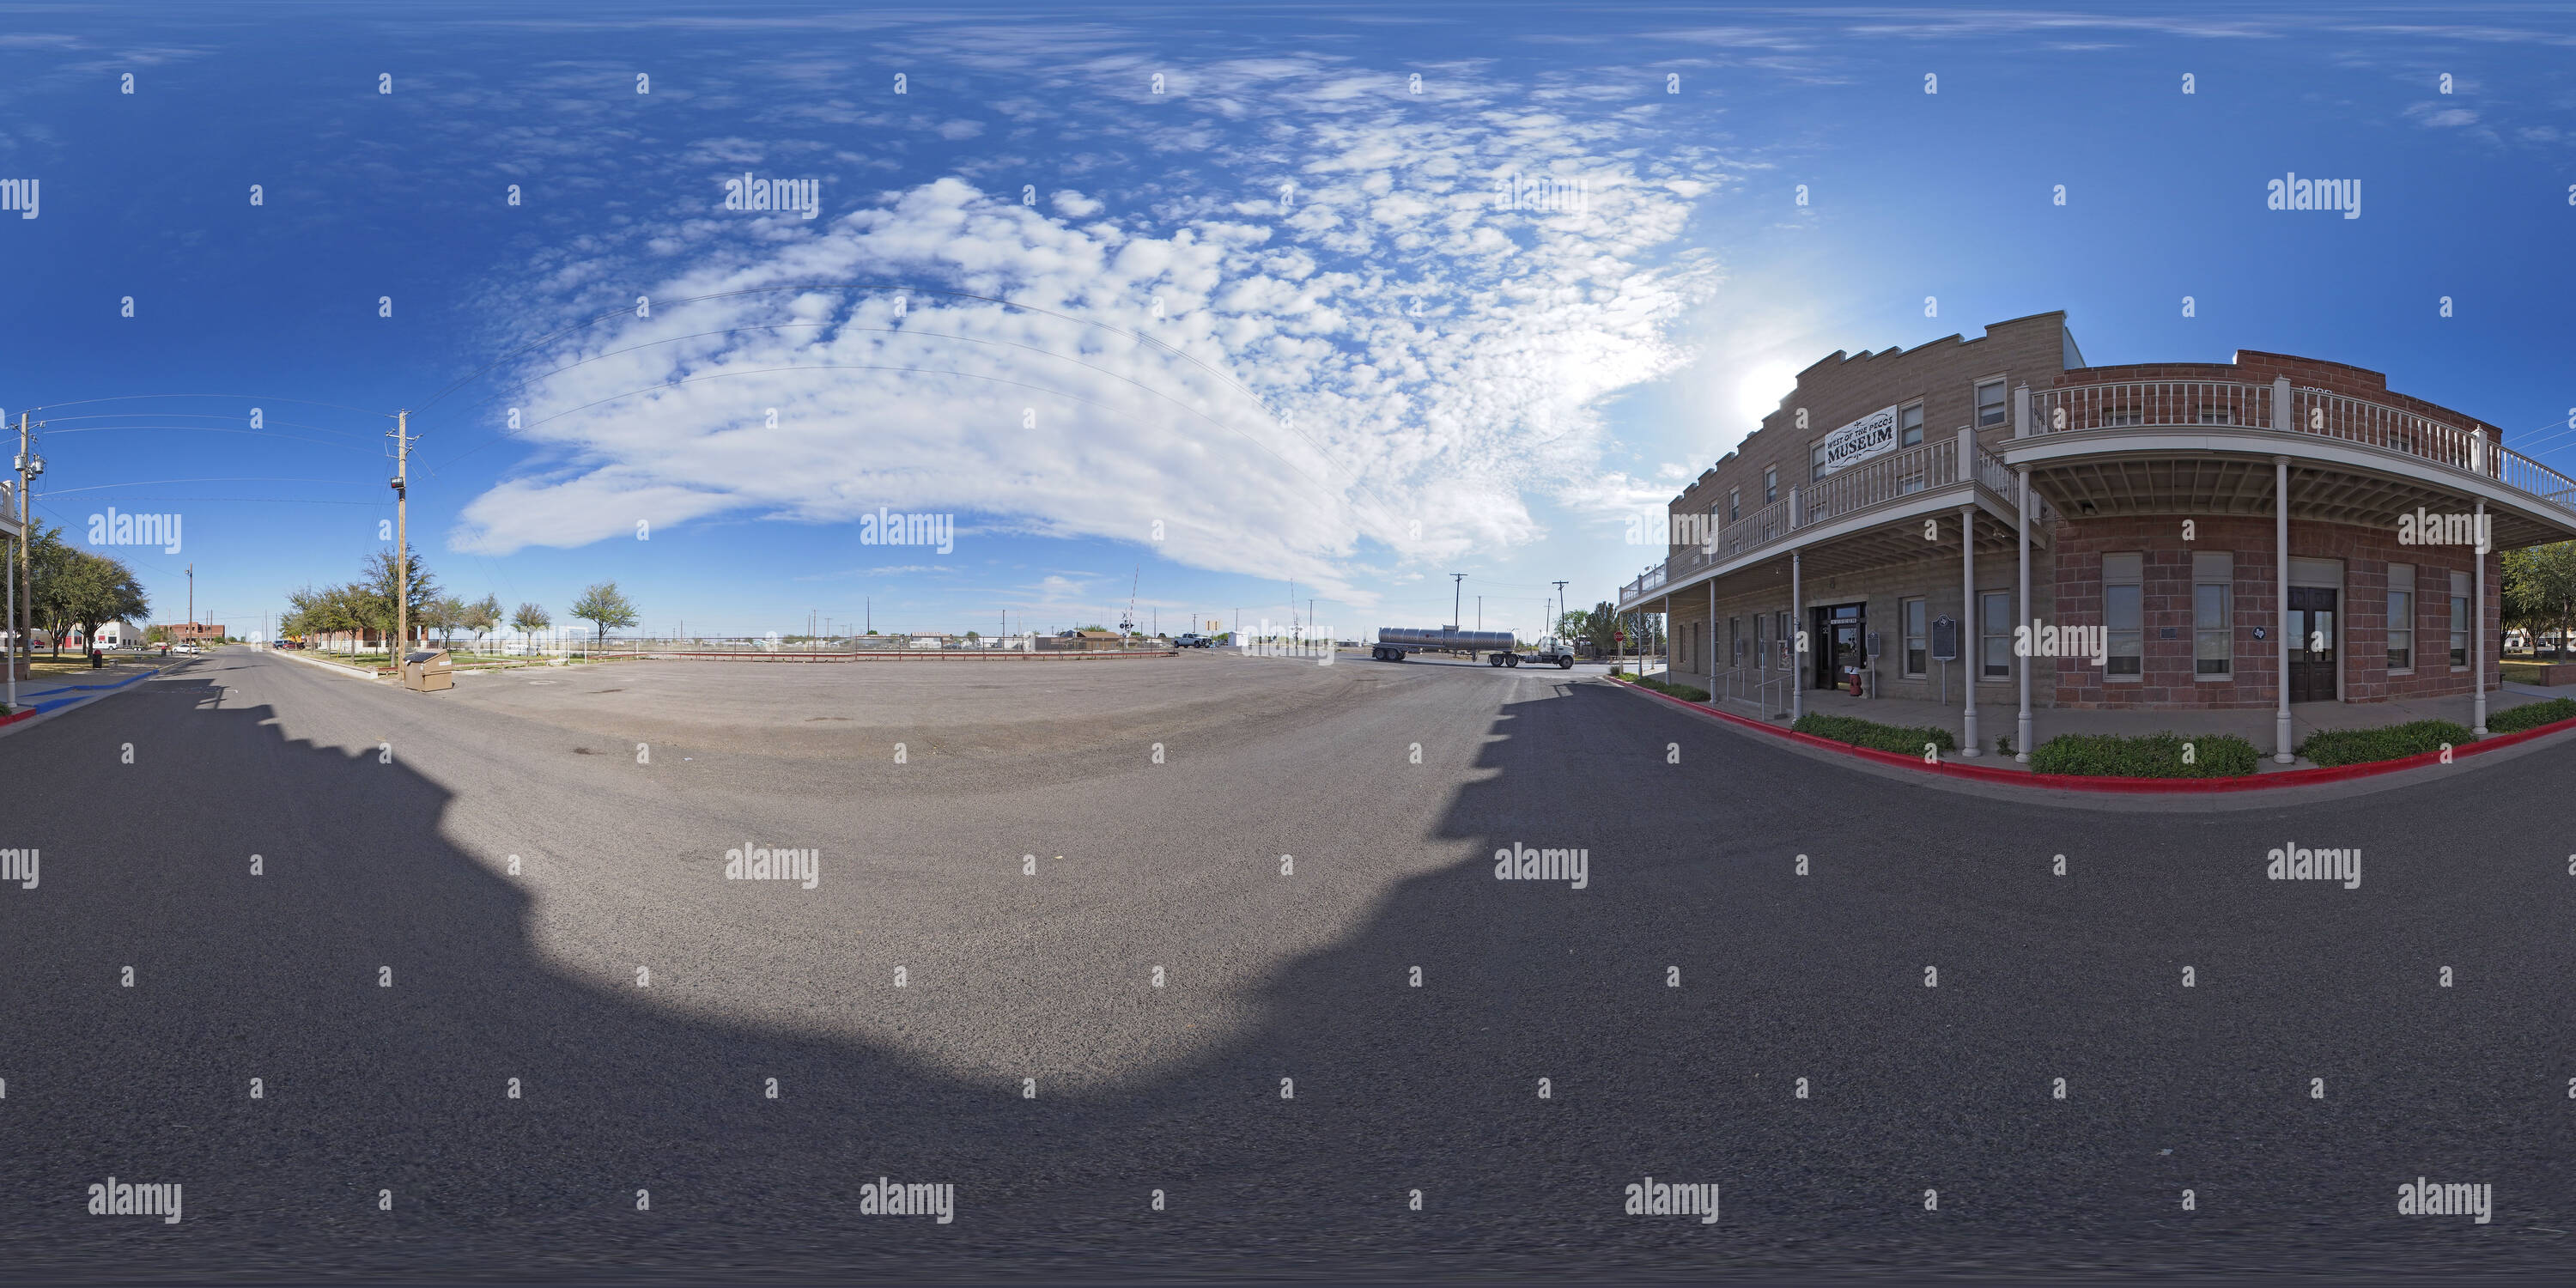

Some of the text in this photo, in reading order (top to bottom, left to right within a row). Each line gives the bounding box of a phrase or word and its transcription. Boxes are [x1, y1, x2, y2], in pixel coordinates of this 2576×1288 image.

[1827, 416, 1893, 449] WEST OF THE PECOS
[1827, 425, 1893, 465] MUSEUM
